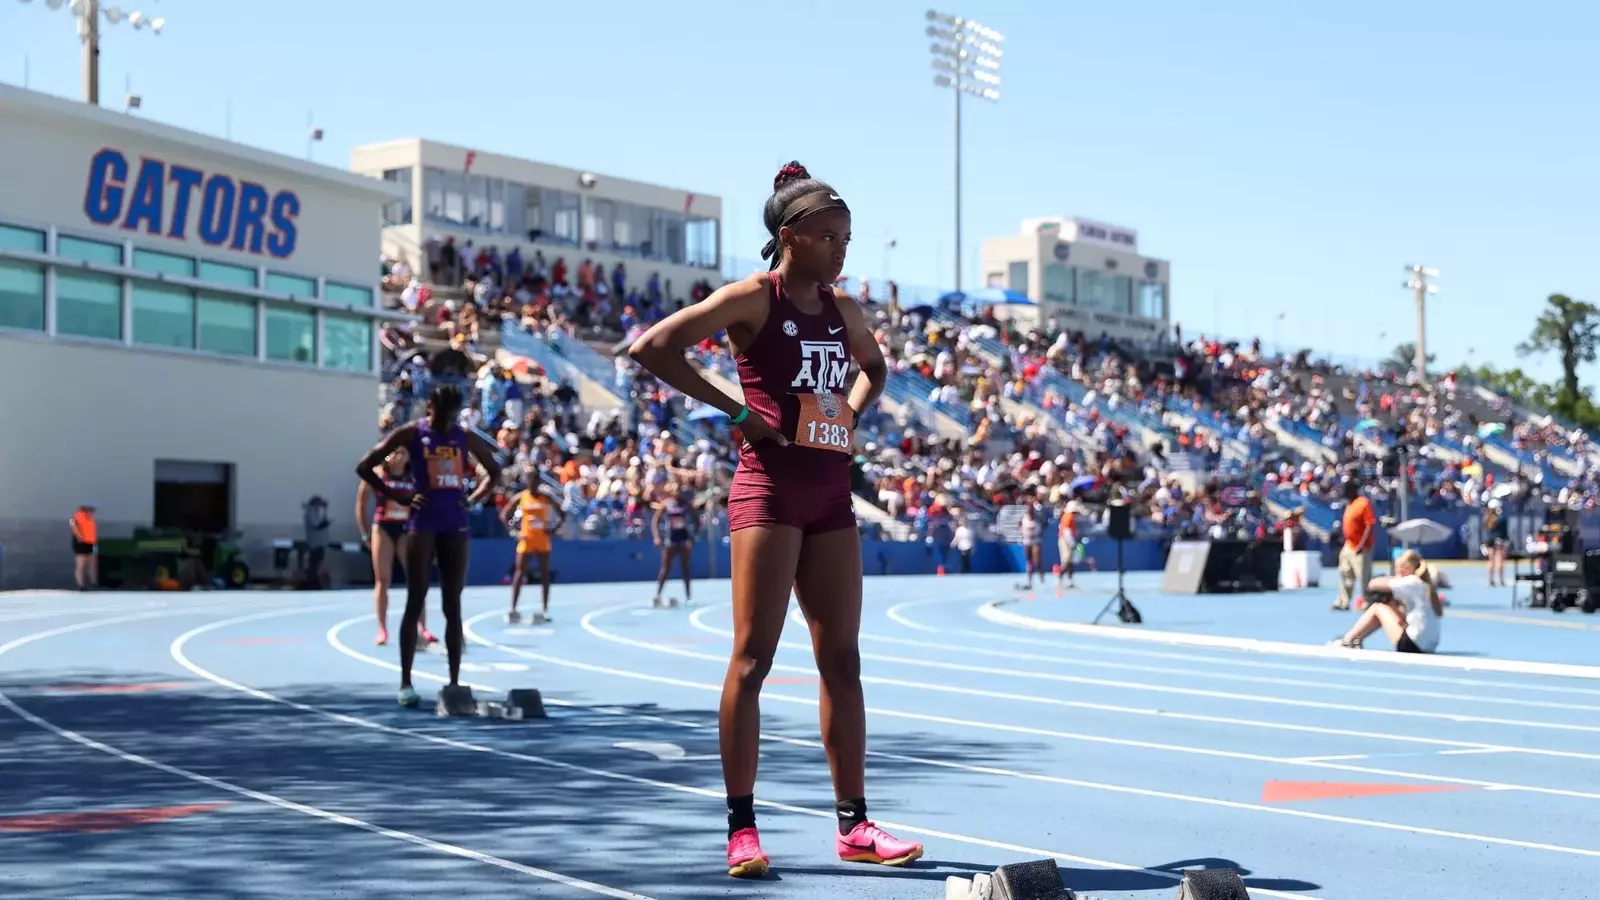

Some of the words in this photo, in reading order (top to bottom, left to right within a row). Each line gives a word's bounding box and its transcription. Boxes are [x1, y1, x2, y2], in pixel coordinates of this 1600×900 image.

[84, 147, 301, 259] GATORS
[807, 420, 849, 448] 1383
[423, 446, 462, 460] LSU
